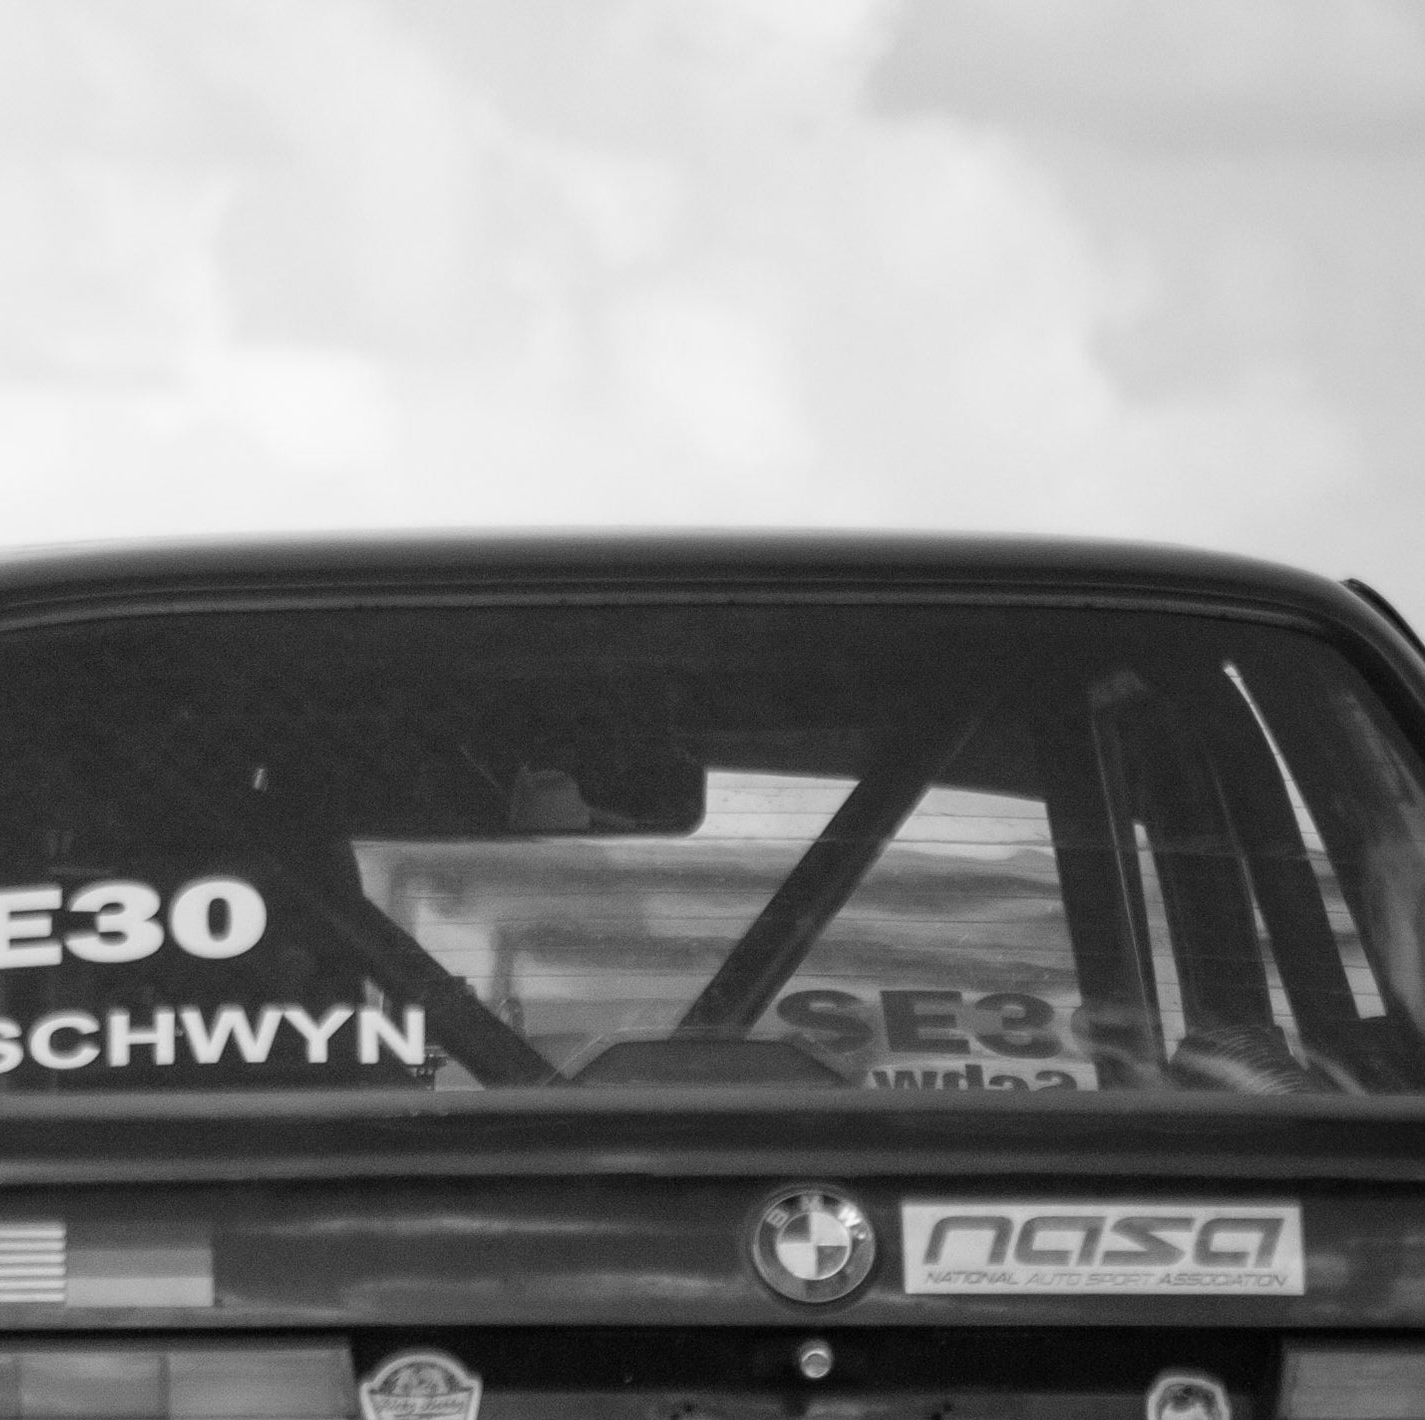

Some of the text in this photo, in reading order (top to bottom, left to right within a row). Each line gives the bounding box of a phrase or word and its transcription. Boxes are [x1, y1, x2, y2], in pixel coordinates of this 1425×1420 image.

[925, 1271, 1288, 1288] NATIONAL AUTO SPORT ASSOCIATION
